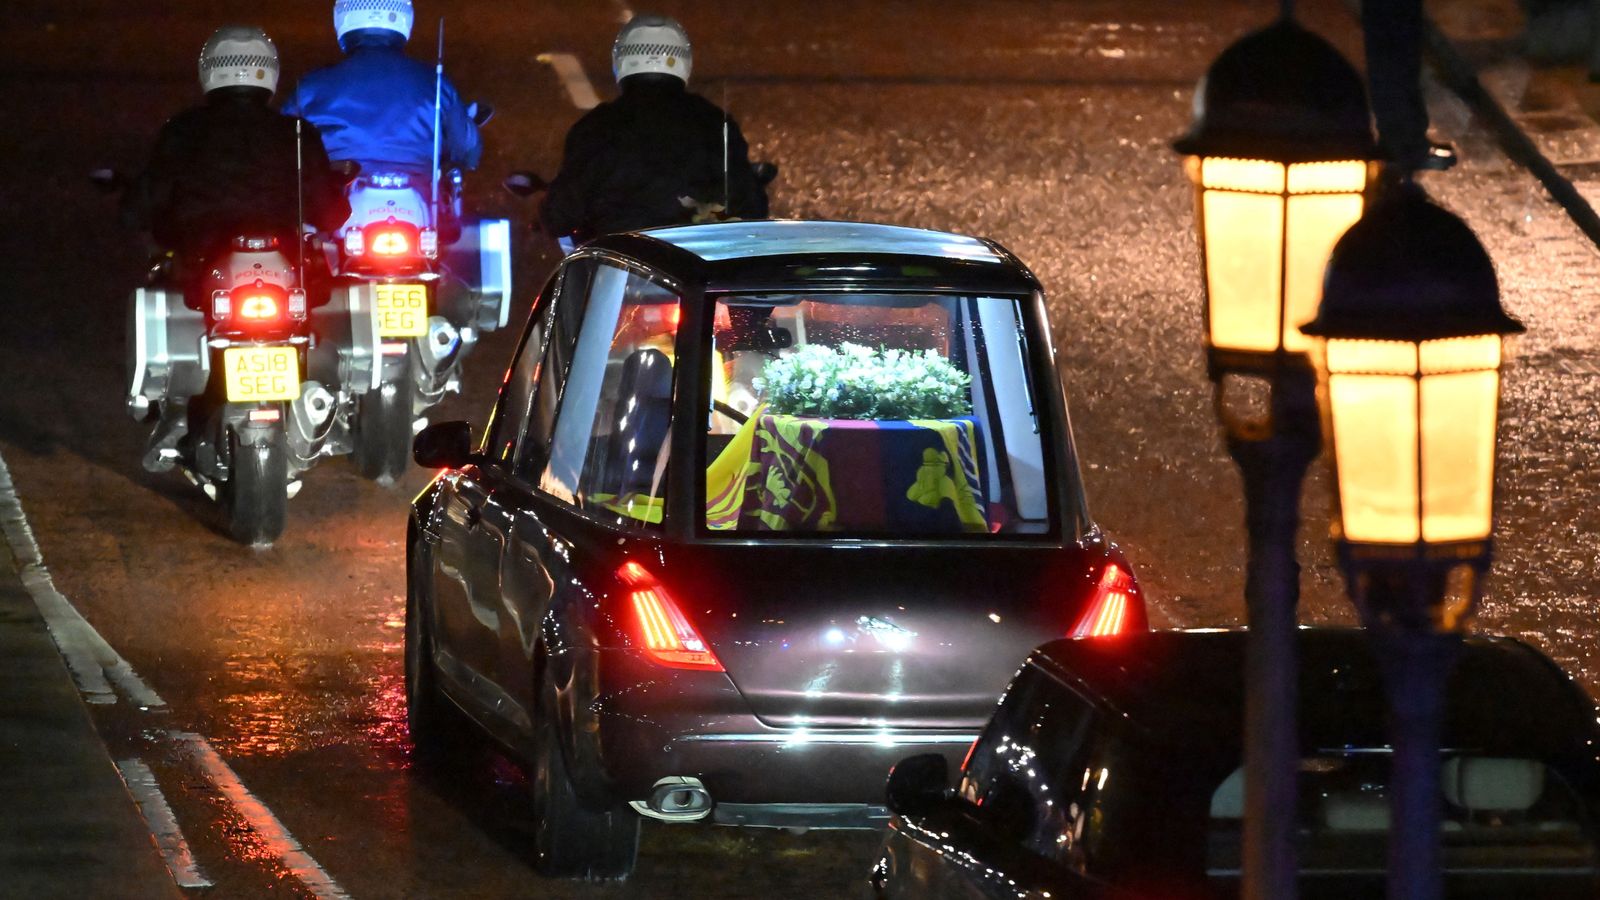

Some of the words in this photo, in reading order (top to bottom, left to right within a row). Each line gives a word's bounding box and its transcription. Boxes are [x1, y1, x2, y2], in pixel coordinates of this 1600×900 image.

[368, 207, 415, 216] POLICE
[235, 270, 281, 280] POLICE
[236, 353, 288, 373] AS18
[239, 375, 286, 394] SEG
